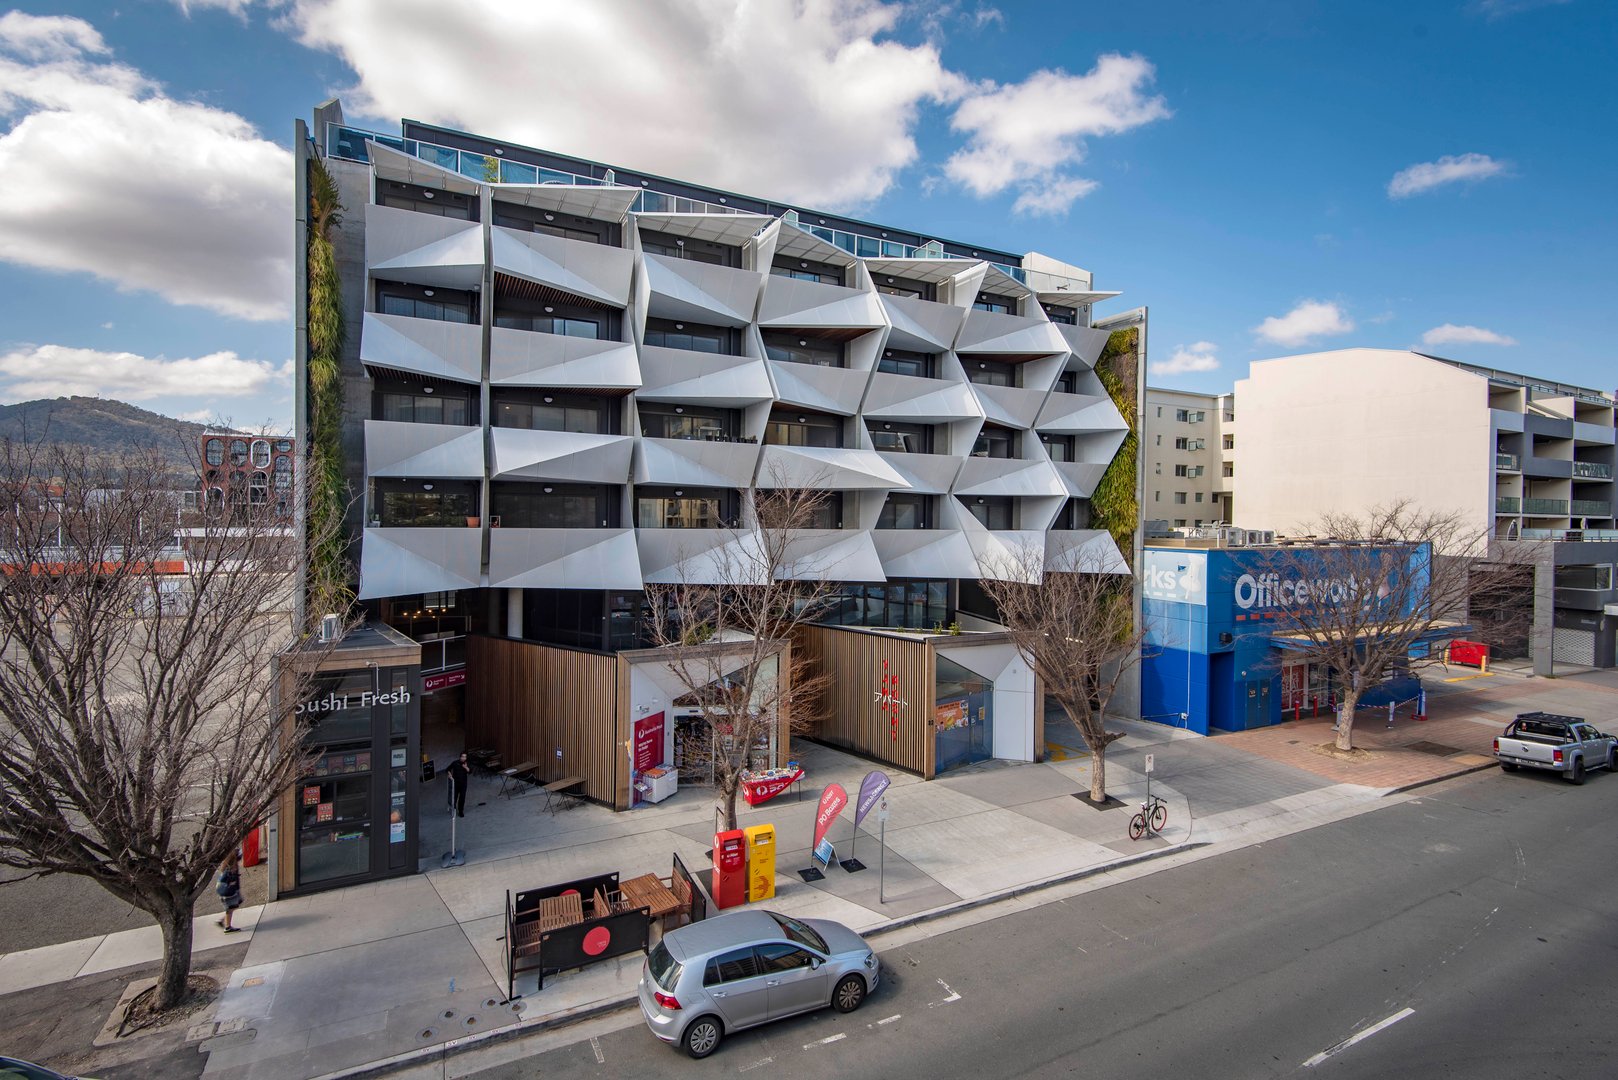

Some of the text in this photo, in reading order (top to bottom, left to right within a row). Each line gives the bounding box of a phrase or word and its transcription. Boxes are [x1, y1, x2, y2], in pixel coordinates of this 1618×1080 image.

[295, 685, 411, 714] Sushi Fresh
[818, 796, 841, 825] PO Boxes
[859, 779, 887, 813] NEWSAGENCY
